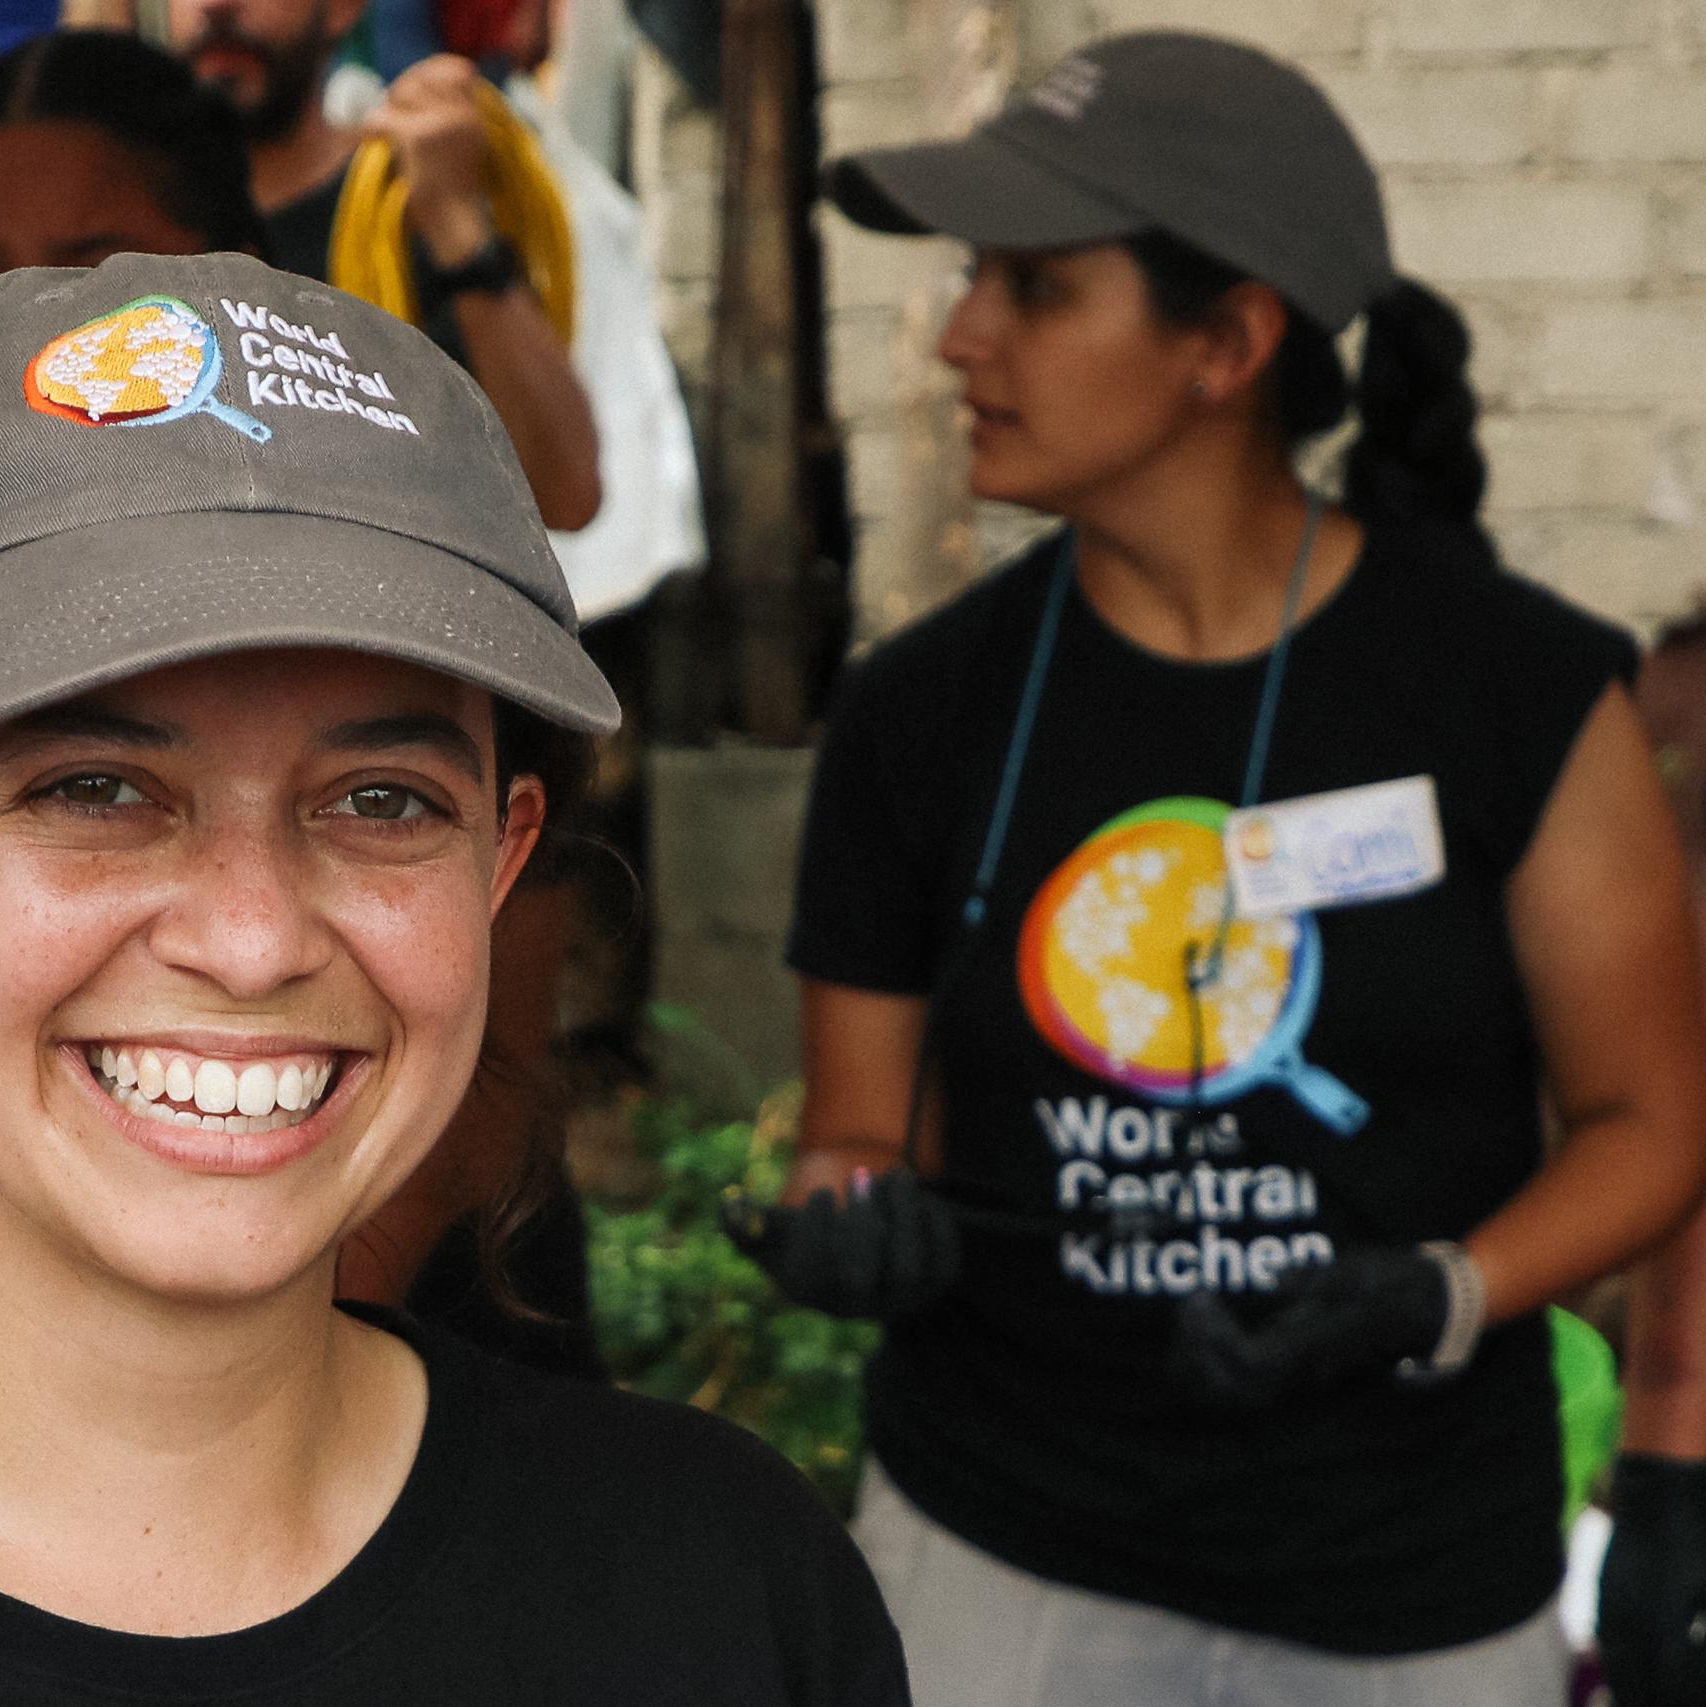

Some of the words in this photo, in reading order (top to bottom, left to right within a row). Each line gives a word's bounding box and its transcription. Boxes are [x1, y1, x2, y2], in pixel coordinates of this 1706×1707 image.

[220, 298, 350, 360] World
[239, 332, 395, 400] Central
[248, 371, 420, 435] Kitchen
